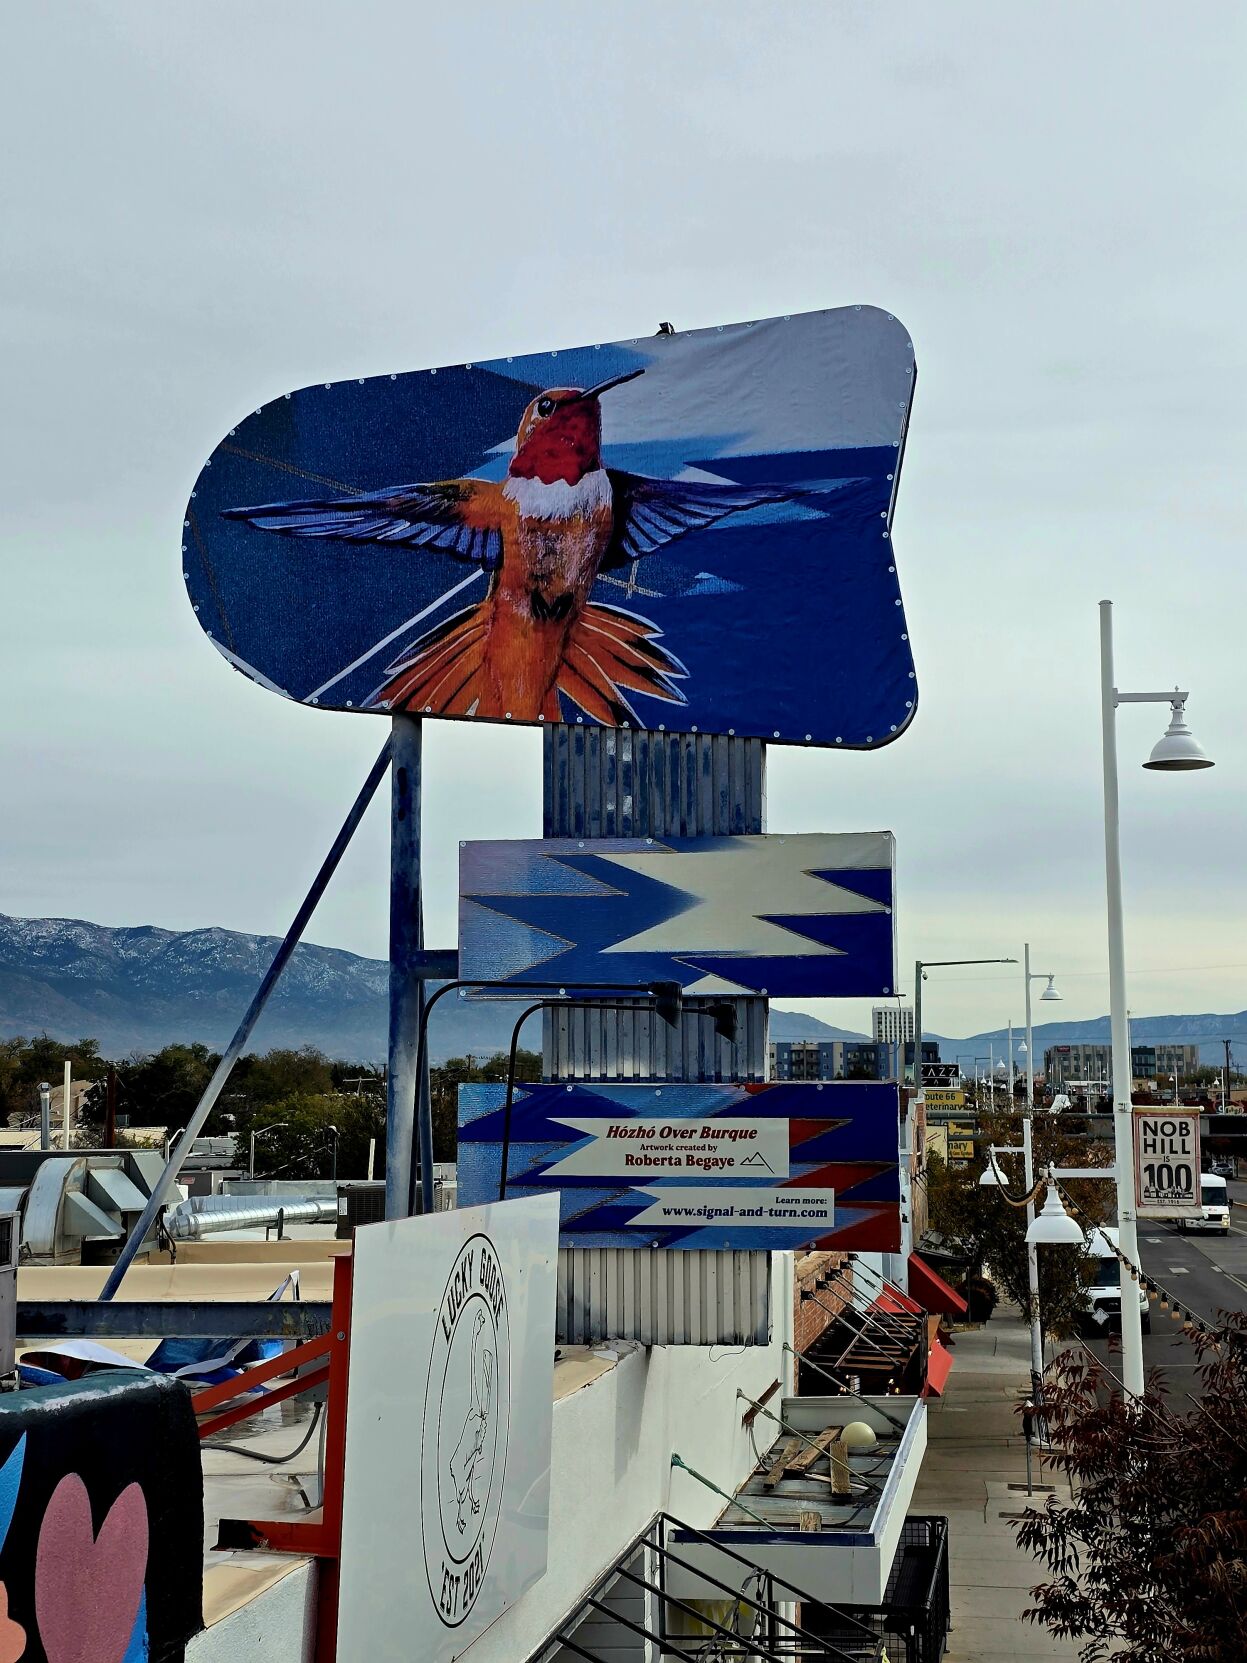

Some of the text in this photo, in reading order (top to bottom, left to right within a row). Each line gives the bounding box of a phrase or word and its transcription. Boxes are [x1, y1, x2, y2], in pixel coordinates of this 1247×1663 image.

[925, 1092, 956, 1101] oute 66
[925, 1102, 963, 1111] eterinary
[606, 1125, 758, 1142] Hózhó Over Burque
[1142, 1120, 1191, 1137] NOB
[639, 1143, 718, 1153] Artwork created by
[1143, 1137, 1191, 1155] HILL
[624, 1153, 735, 1171] Roberta Begaye
[1163, 1155, 1171, 1163] IS
[1143, 1163, 1192, 1193] 100
[775, 1196, 828, 1205] Learn more:
[662, 1205, 828, 1220] www.signal-and-turn.com
[441, 1247, 504, 1346] LUCKY GOOSE
